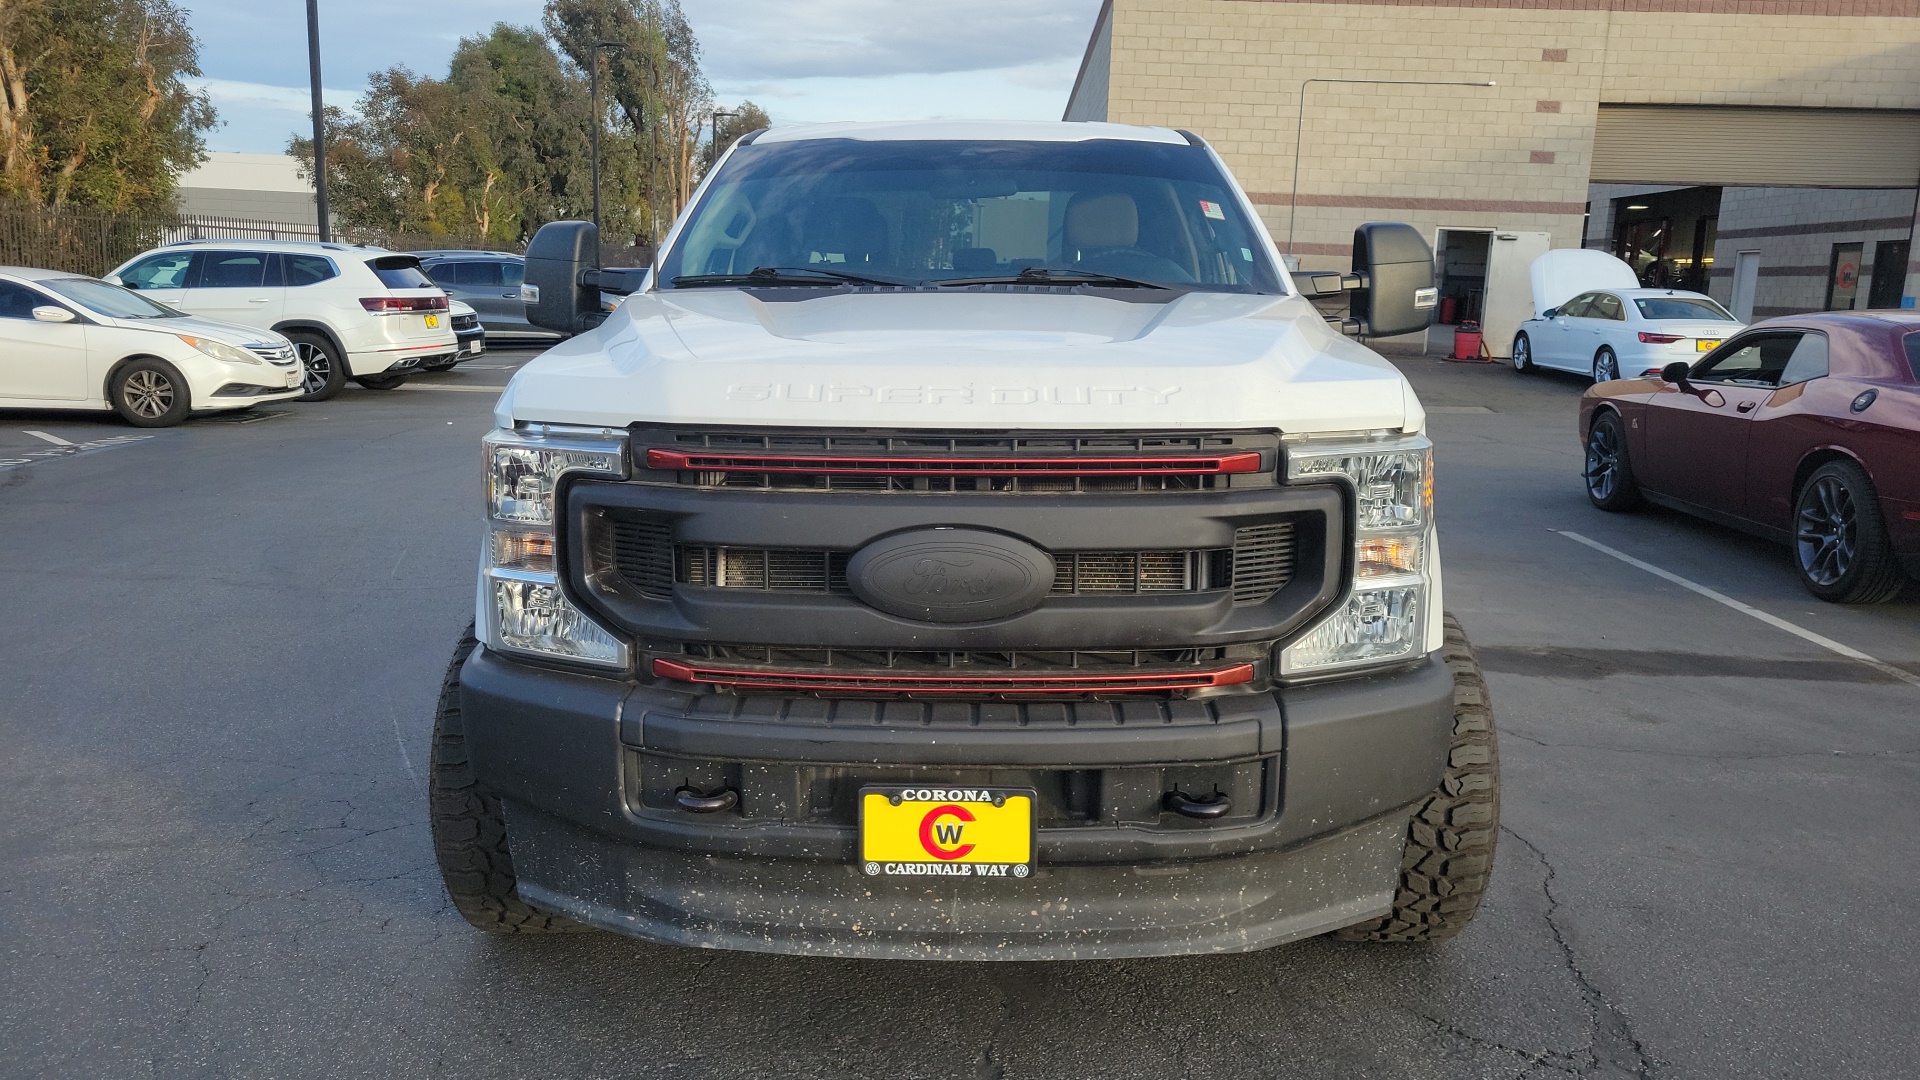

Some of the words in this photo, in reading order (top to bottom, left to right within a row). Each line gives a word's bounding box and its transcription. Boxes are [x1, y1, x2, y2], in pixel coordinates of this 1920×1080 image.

[725, 383, 974, 404] SUPER
[991, 385, 1182, 405] DUTY
[903, 557, 997, 595] Ford
[901, 789, 993, 802] CORONA
[885, 863, 972, 876] CARDINALE
[976, 864, 1010, 876] WAY
